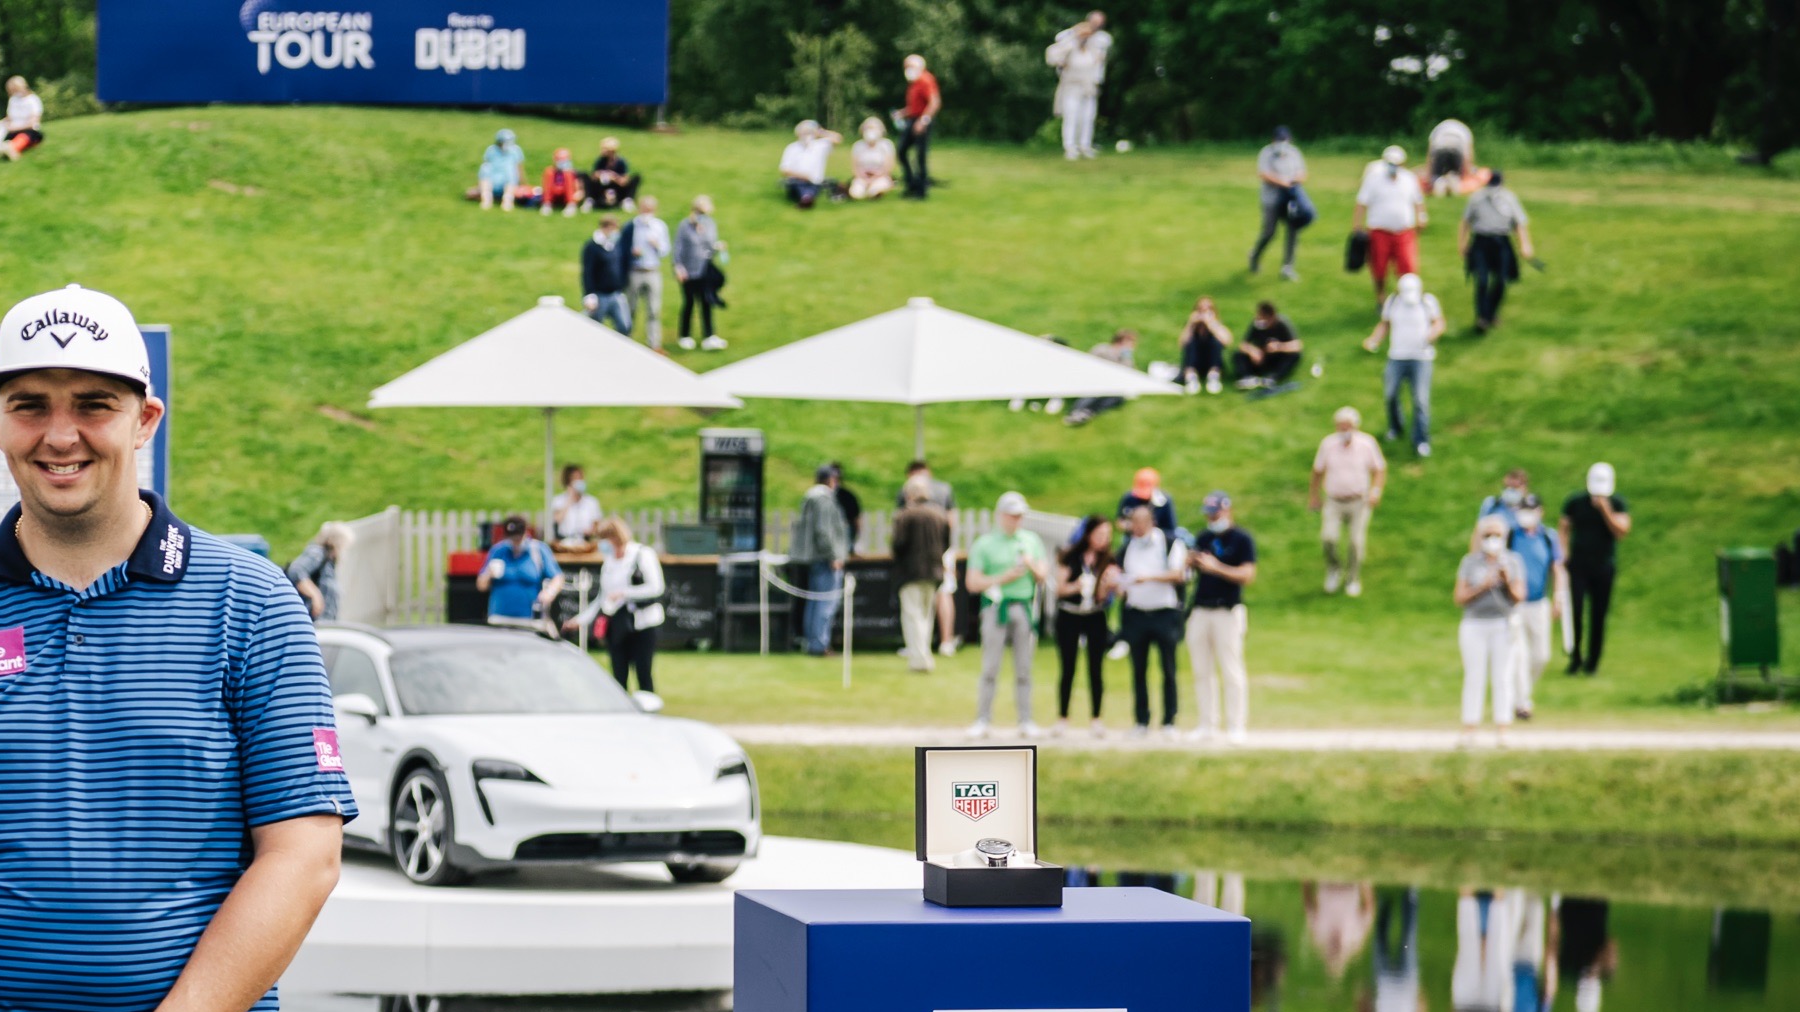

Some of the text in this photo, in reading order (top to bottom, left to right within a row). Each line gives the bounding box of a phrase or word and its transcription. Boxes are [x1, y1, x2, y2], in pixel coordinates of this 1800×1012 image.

[257, 11, 372, 32] EUROPEAN
[247, 29, 376, 76] TOUR
[415, 28, 526, 75] DUBAI
[20, 308, 109, 341] Callaway
[163, 524, 178, 574] DUNKIRK
[956, 785, 994, 797] TAG
[956, 800, 996, 818] HEUER
